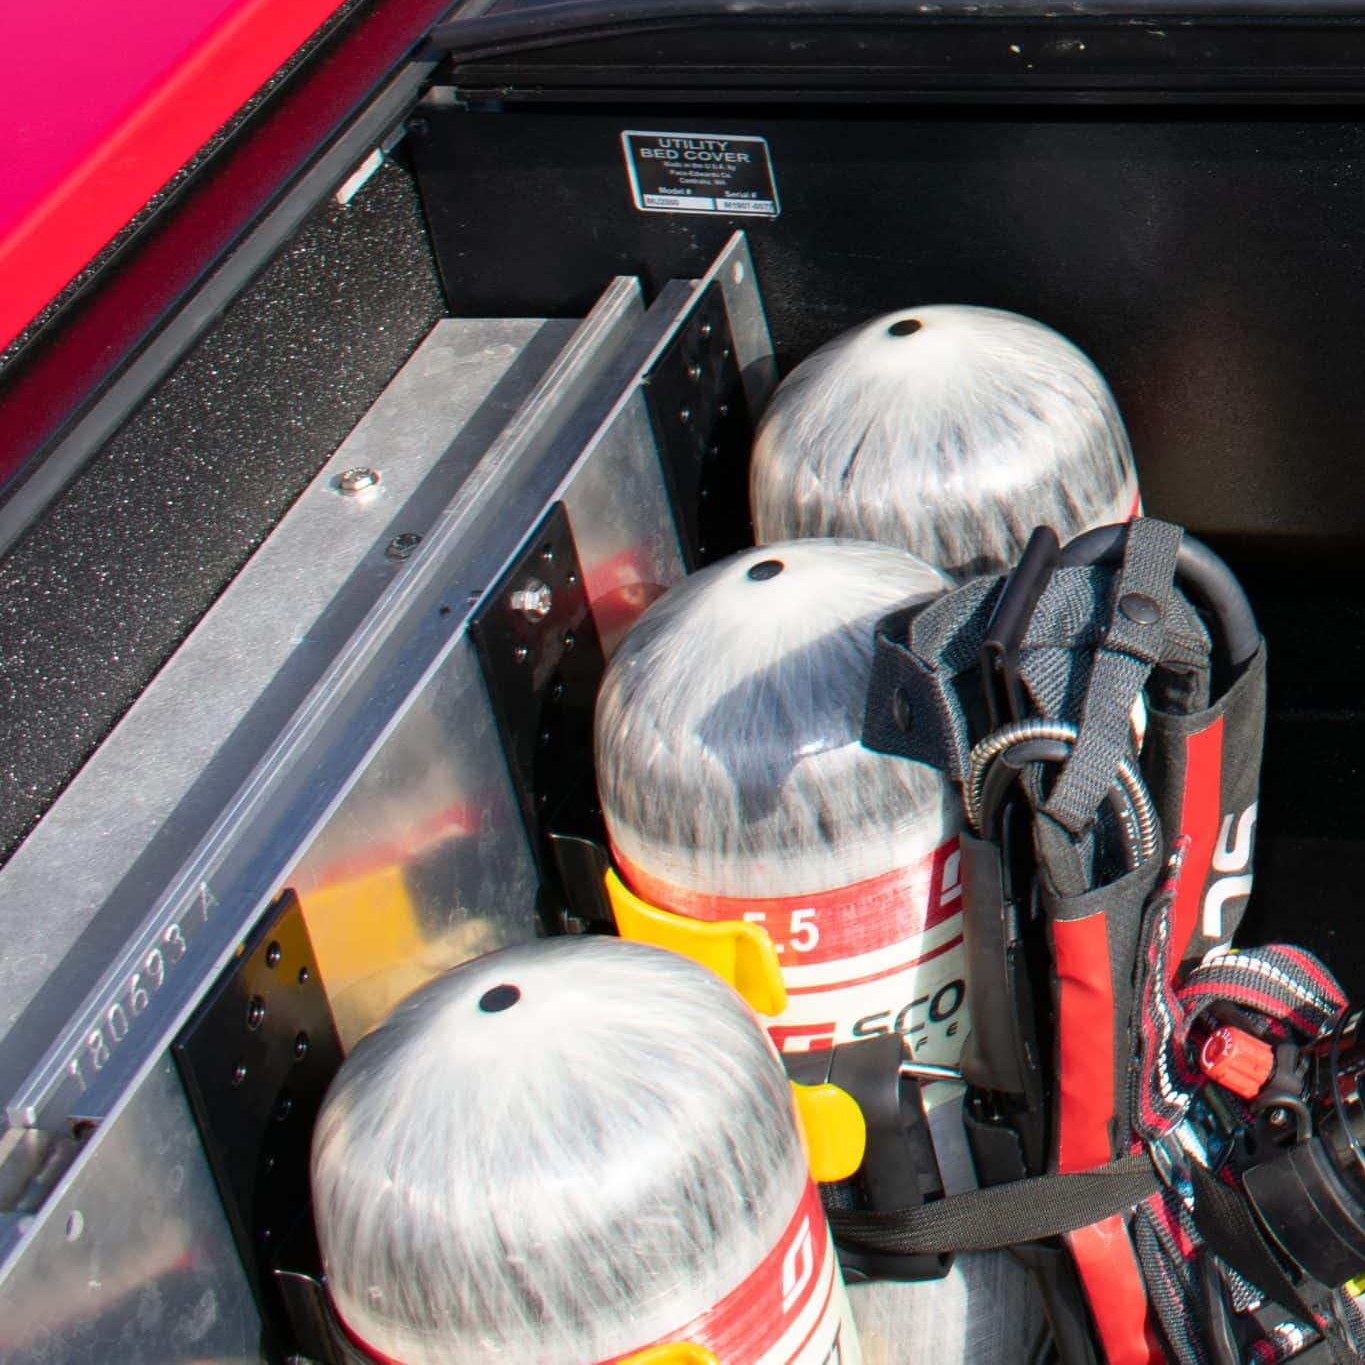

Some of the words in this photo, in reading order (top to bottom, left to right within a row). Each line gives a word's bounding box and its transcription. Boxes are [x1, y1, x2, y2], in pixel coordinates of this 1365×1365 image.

[658, 138, 728, 151] UTILITY
[640, 148, 679, 159] BED
[684, 150, 751, 163] COVER
[67, 923, 186, 1091] 180693
[199, 881, 219, 922] A
